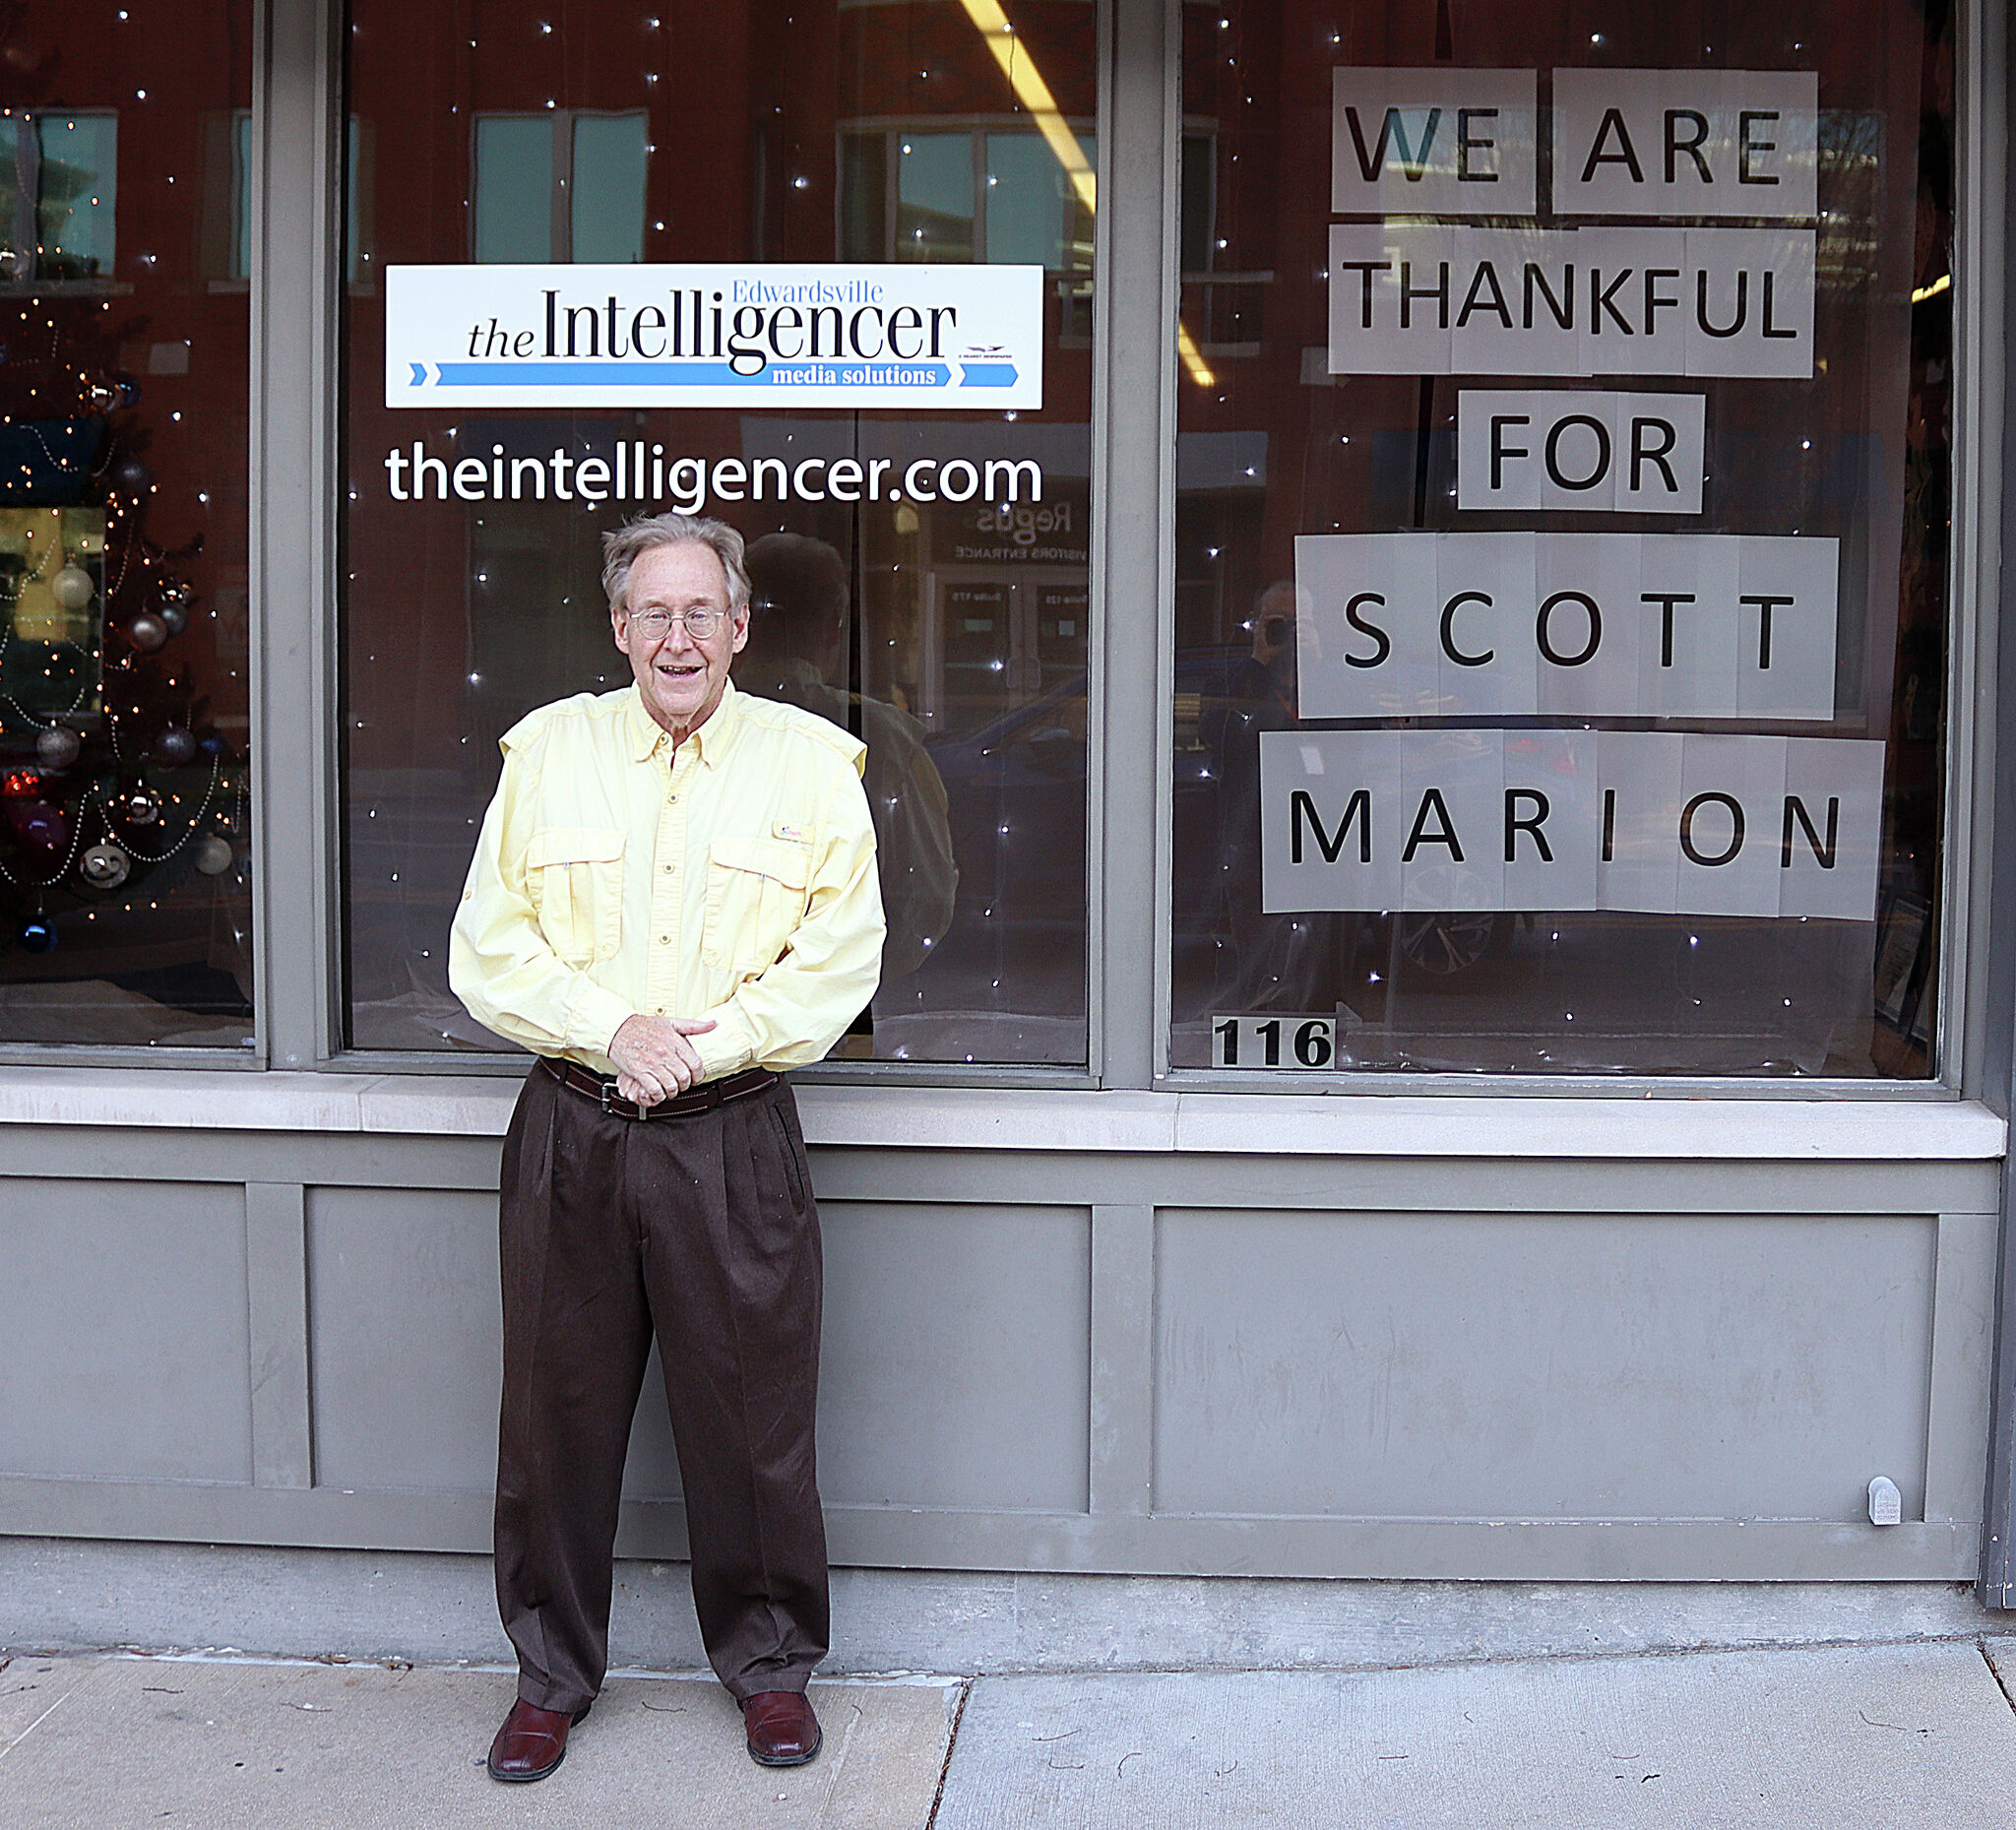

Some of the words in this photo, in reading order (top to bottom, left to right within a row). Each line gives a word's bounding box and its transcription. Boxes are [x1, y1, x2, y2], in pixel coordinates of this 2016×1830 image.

[1345, 106, 1499, 182] WE
[1580, 108, 1780, 185] ARE
[731, 280, 884, 304] Edwardsville
[1342, 261, 1797, 339] THANKFUL
[468, 317, 536, 358] the
[539, 289, 958, 376] Intelligencer
[773, 365, 837, 385] media
[842, 365, 936, 385] solutions
[385, 441, 1042, 514] theintelligencer.com
[1489, 414, 1679, 493] FOR
[1345, 591, 1794, 669] SCOTT
[1290, 788, 1839, 869] MARION
[1214, 1019, 1333, 1067] 116
